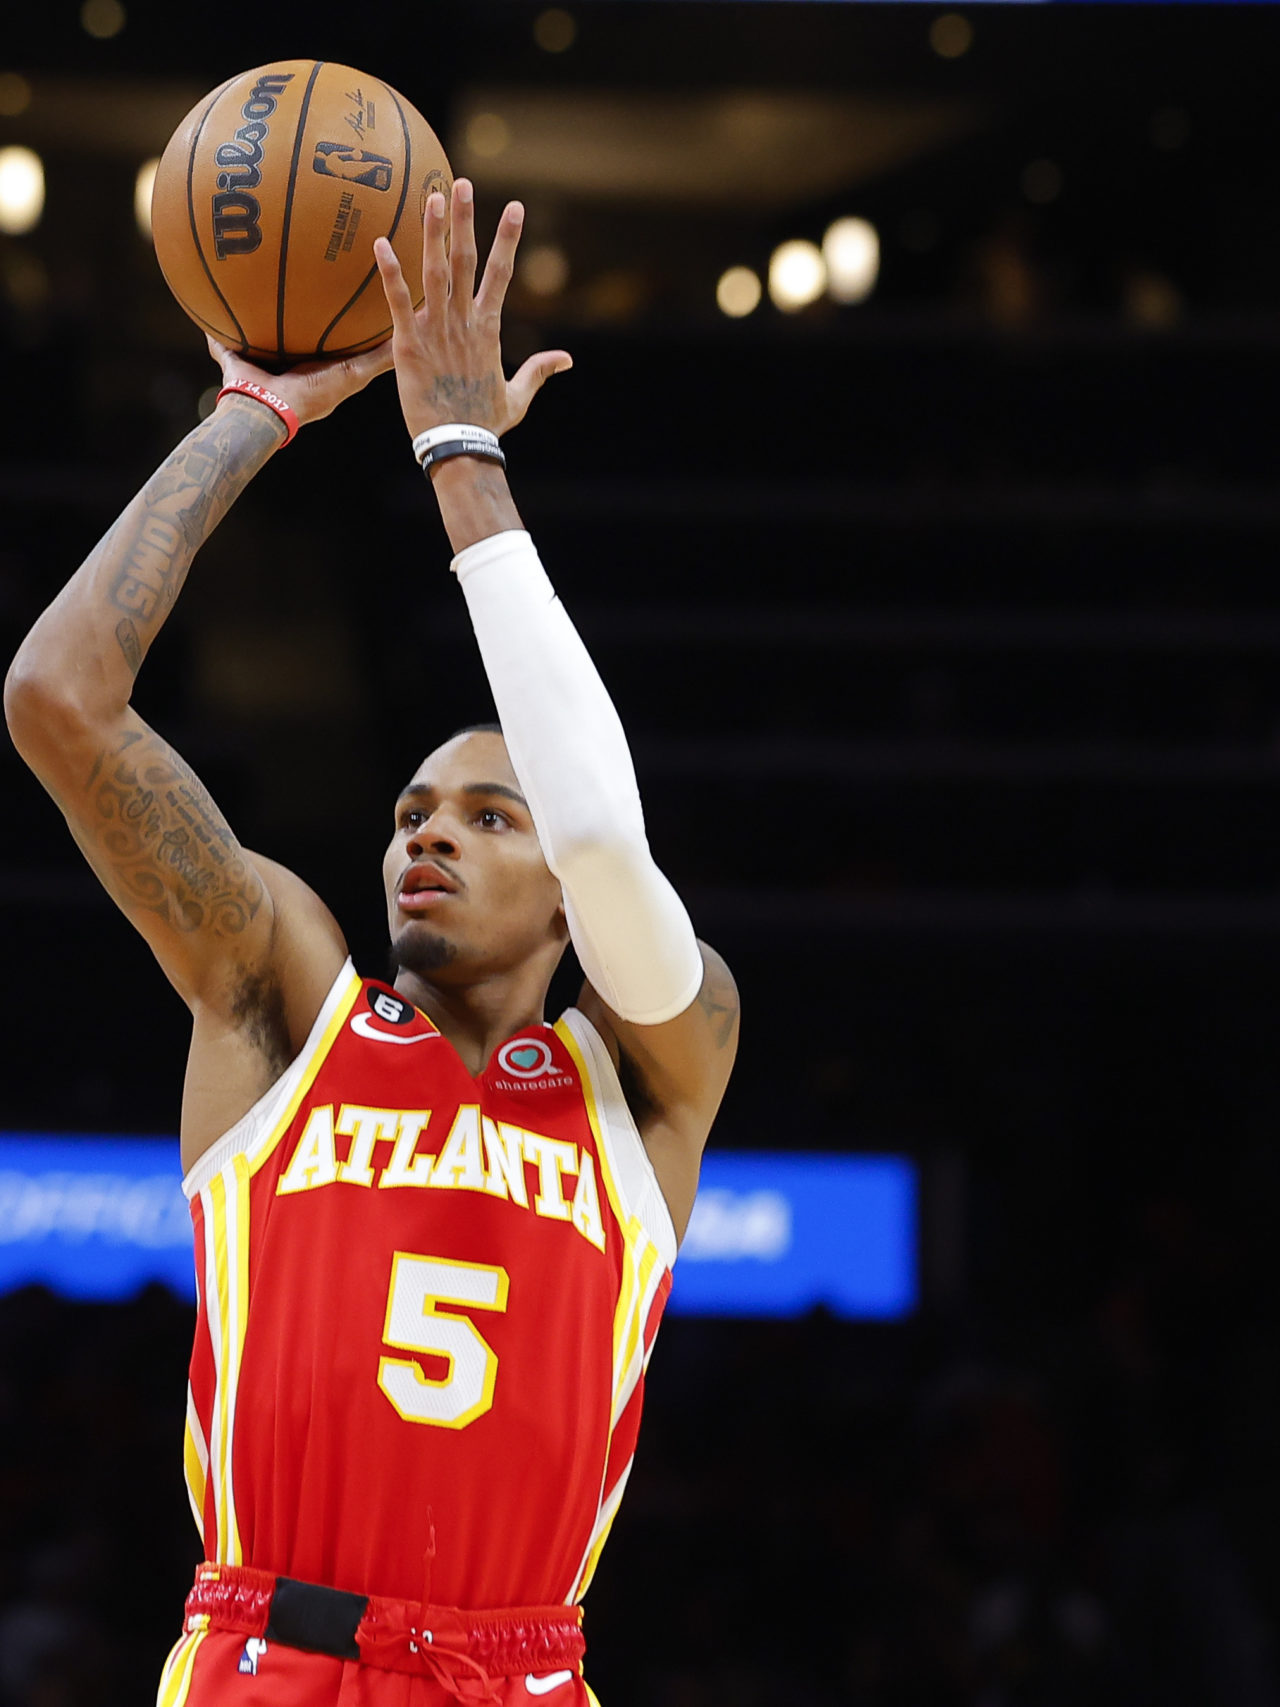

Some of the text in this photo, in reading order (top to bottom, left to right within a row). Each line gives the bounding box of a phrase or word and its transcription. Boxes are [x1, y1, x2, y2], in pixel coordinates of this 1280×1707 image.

[212, 73, 295, 260] Wilson
[339, 191, 354, 210] BALL
[333, 208, 350, 231] GAME
[245, 382, 261, 396] 14,
[260, 389, 289, 412] 2017
[374, 993, 403, 1023] 6
[495, 1076, 573, 1091] sharecare
[275, 1102, 606, 1255] ATLANTA
[376, 1250, 510, 1430] 5
